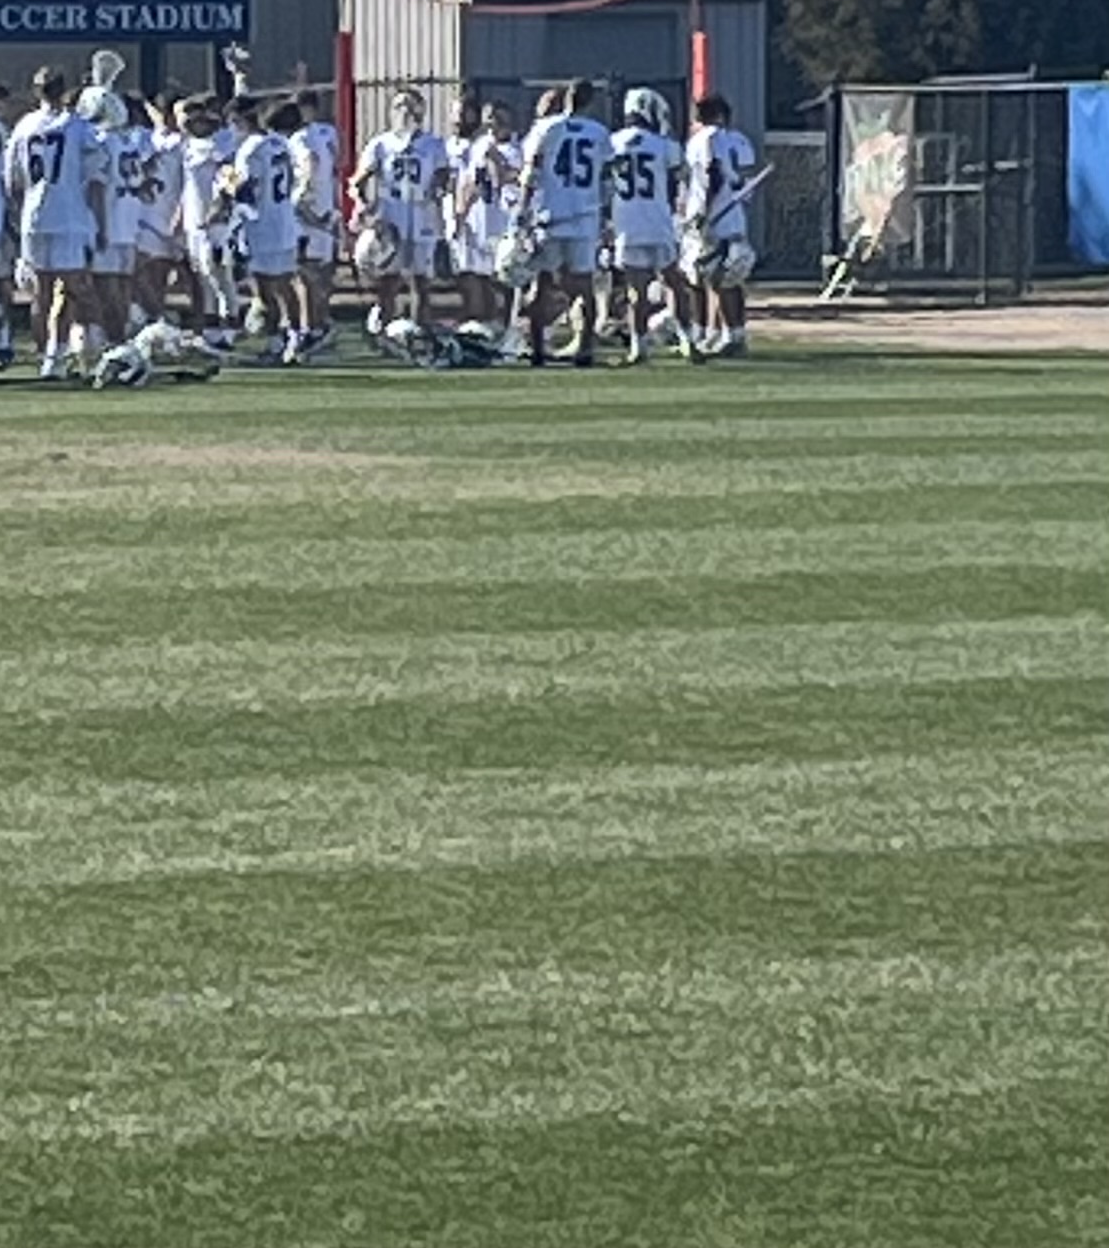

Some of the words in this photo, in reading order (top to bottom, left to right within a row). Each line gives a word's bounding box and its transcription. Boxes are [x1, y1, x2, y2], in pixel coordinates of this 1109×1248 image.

[94, 4, 244, 31] STADIUM
[28, 132, 65, 185] 67
[552, 137, 595, 189] 45
